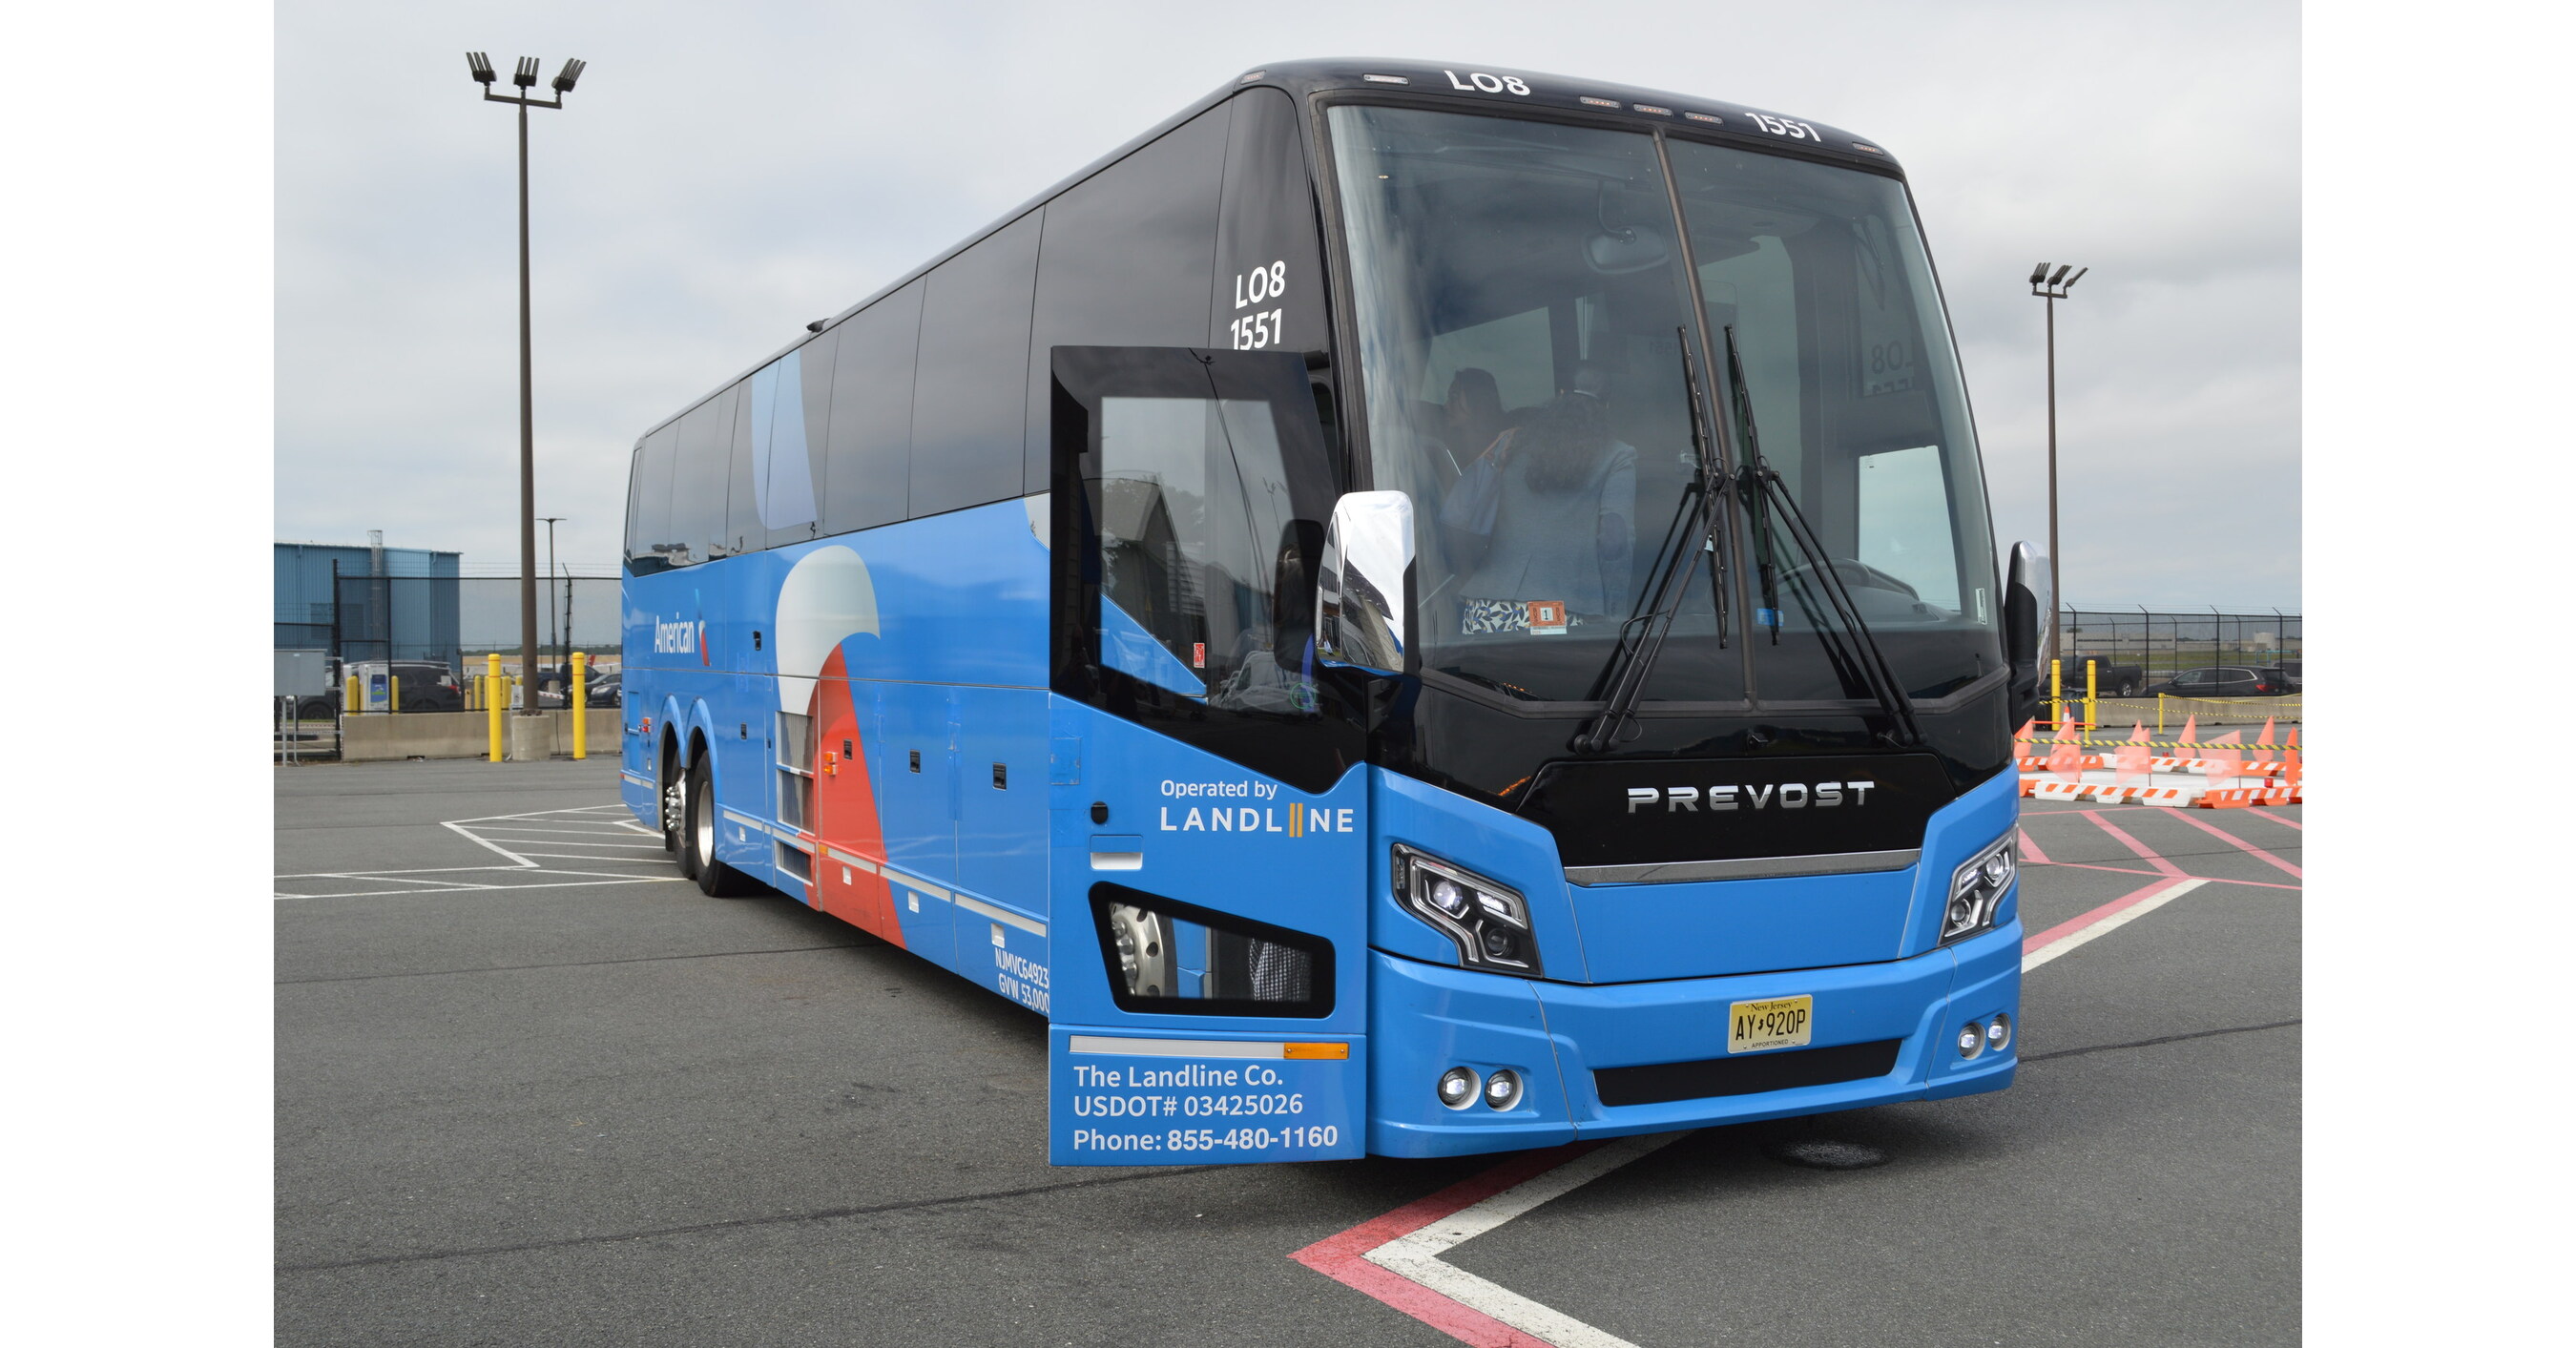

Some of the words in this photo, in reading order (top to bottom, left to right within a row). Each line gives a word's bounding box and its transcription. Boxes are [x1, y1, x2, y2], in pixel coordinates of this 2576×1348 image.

[1444, 70, 1531, 96] LO8
[1744, 113, 1822, 142] 1551
[1236, 260, 1286, 309] LO8
[1231, 308, 1282, 351] 1551
[654, 611, 696, 654] American
[1161, 779, 1248, 798] Operated
[1255, 780, 1278, 800] by
[1628, 780, 1876, 814] PREVOST
[999, 973, 1019, 1000] GVW
[1751, 1003, 1770, 1012] New
[1770, 1002, 1793, 1012] Jersey
[1752, 1039, 1789, 1048] APPORTIONED
[1074, 1066, 1121, 1087] The
[1129, 1065, 1238, 1087] Landline
[1244, 1065, 1283, 1086] Co.
[1074, 1095, 1177, 1117] USDOT#
[1184, 1093, 1304, 1116] 03425026
[1074, 1129, 1162, 1151] Phone:
[1167, 1126, 1339, 1150] 855-480-1160
